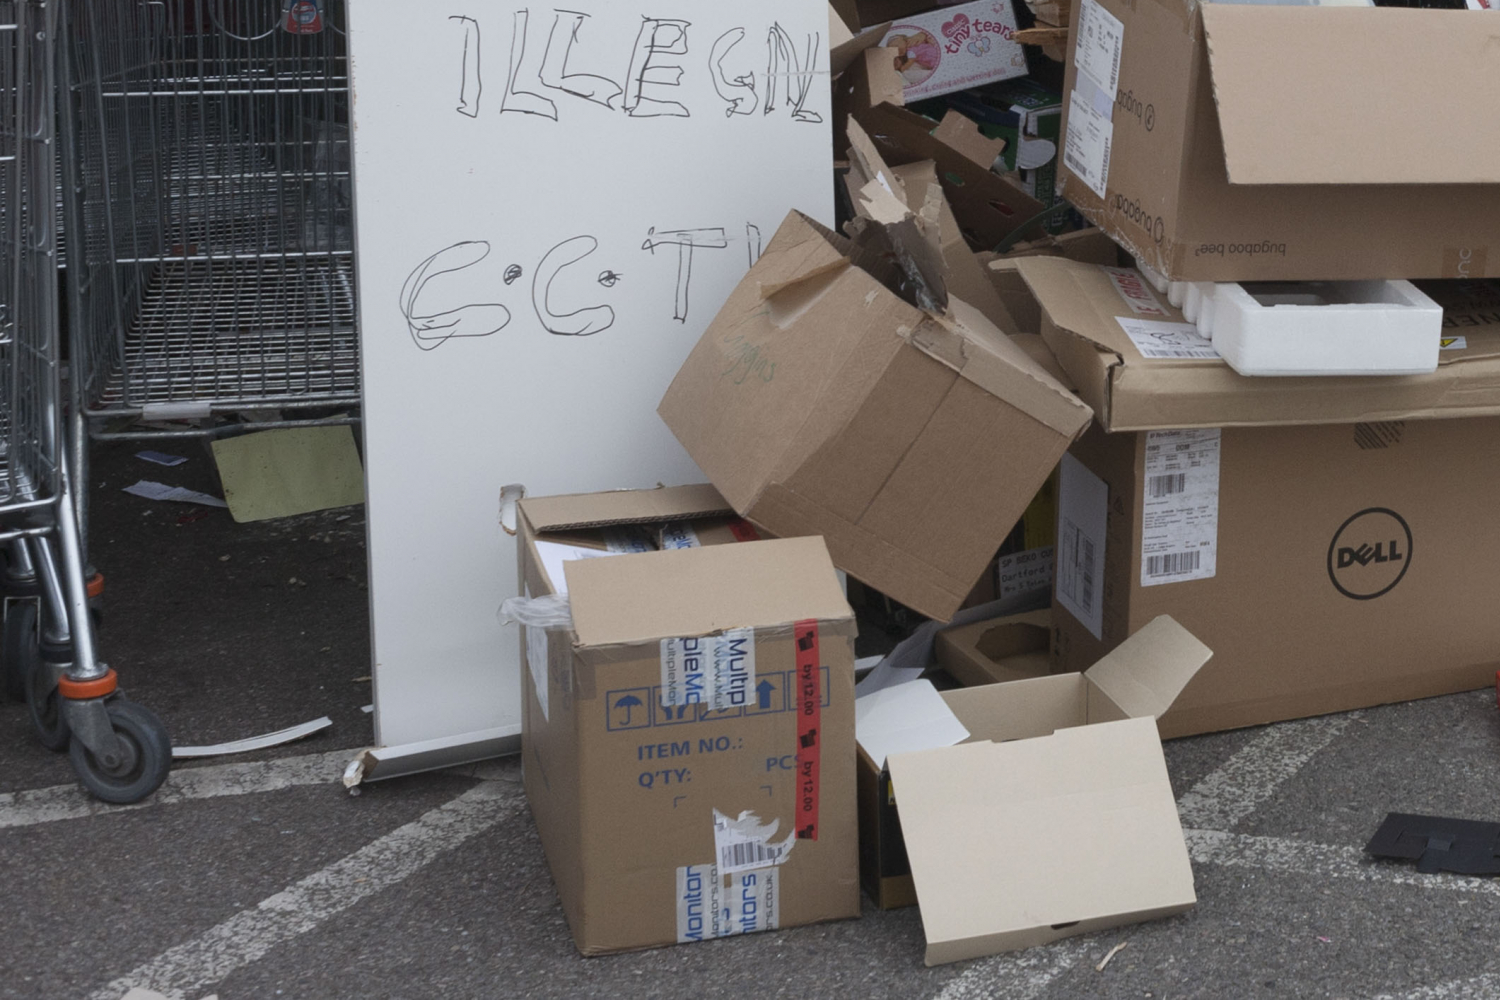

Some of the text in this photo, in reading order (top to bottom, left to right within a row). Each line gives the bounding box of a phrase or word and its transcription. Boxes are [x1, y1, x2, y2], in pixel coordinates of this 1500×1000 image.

[943, 18, 1015, 54] tiny tears
[1228, 240, 1286, 257] bugaboo
[1337, 543, 1403, 570] DELL
[1001, 565, 1046, 583] Dartford
[728, 638, 749, 706] Multip
[803, 664, 815, 716] by 12.00
[637, 736, 744, 762] ITEM NO.:
[638, 769, 693, 789] Q'TY:
[803, 761, 815, 812] by 12.00
